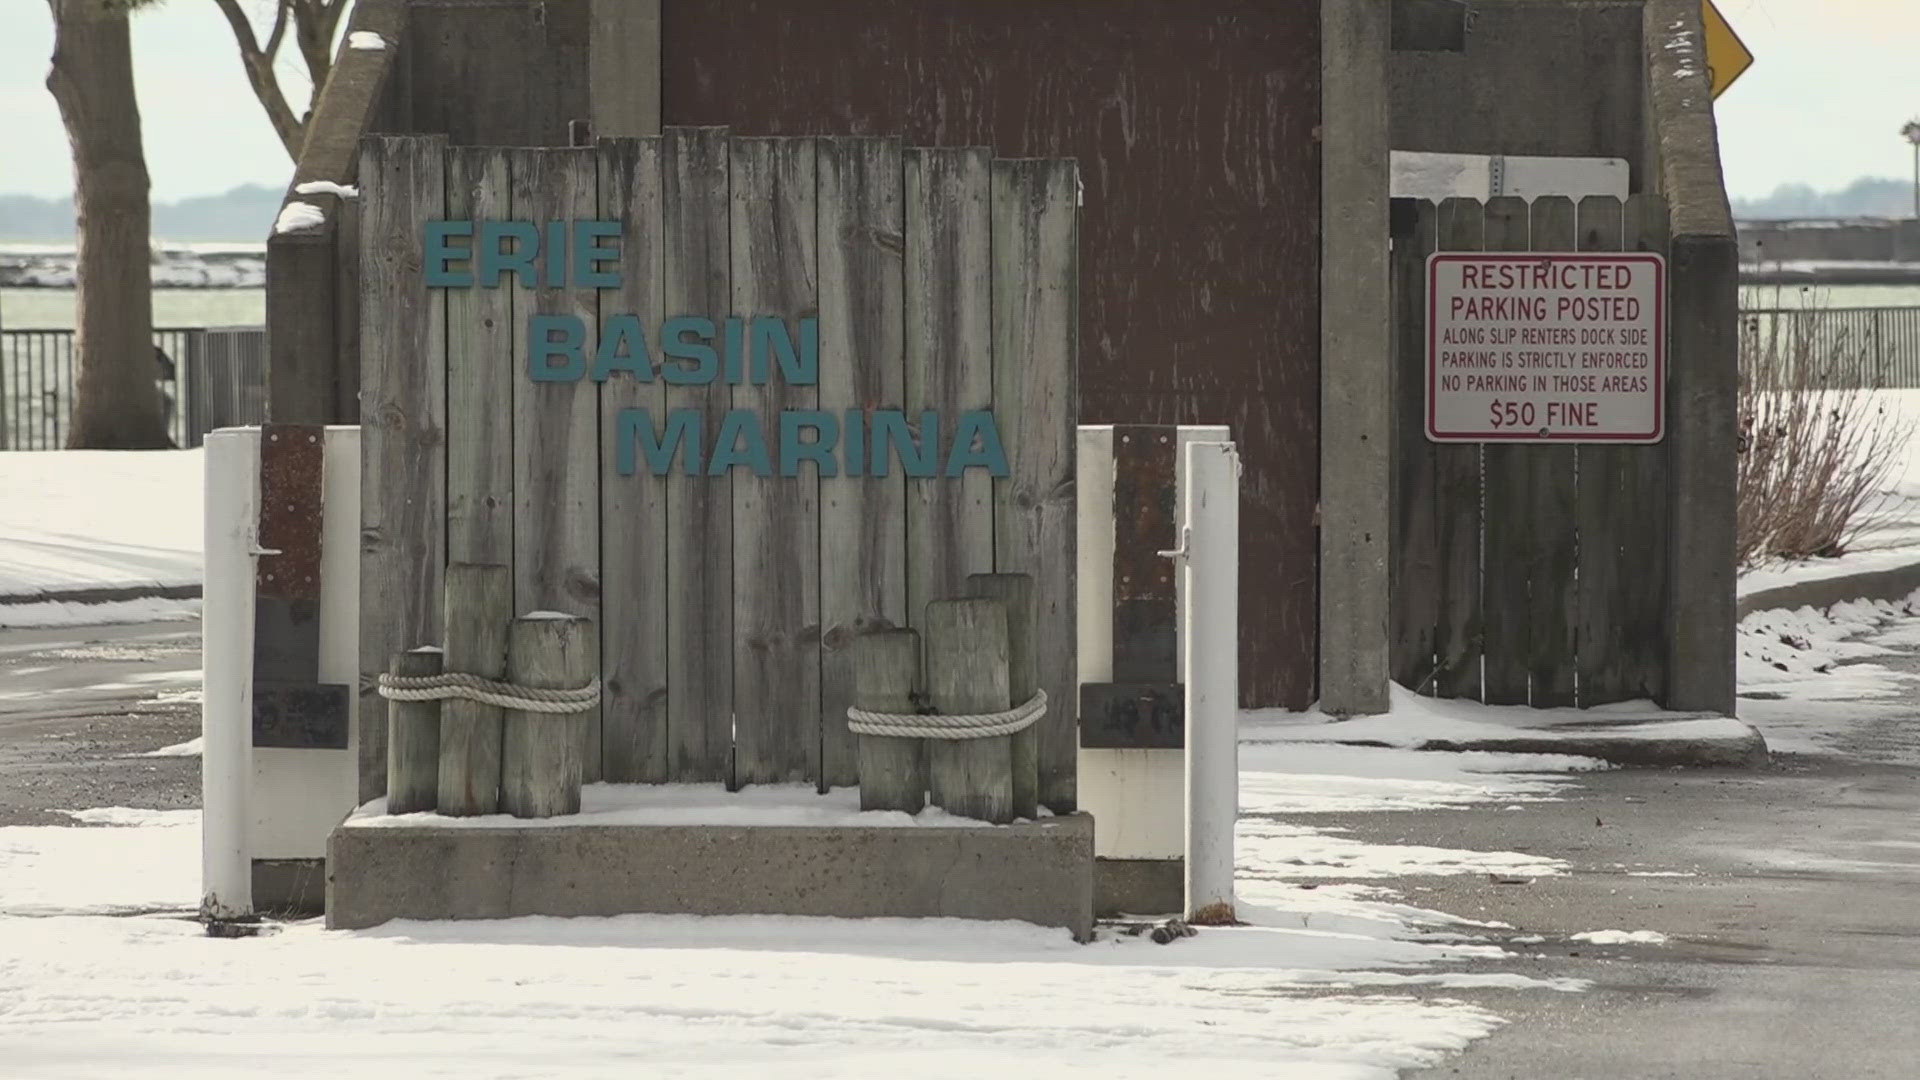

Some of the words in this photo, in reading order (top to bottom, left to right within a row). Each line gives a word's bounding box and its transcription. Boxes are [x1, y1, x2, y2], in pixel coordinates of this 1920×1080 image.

[424, 220, 623, 288] ERIE
[1462, 265, 1632, 290] RESTRICTED
[1451, 297, 1547, 321] PARKING
[1557, 297, 1640, 321] POSTED
[1443, 328, 1485, 345] ALONG
[1490, 328, 1517, 345] SLIP
[1522, 328, 1576, 345] RENTERS
[1581, 328, 1615, 345] DOCK
[1620, 328, 1648, 345] SIDE
[529, 314, 819, 385] BASIN
[1442, 352, 1496, 368] PARKING
[1502, 352, 1513, 368] IS
[1518, 352, 1576, 368] STRICTLY
[1582, 352, 1648, 369] ENFORCED
[1442, 375, 1460, 392] NO
[1467, 375, 1527, 392] PARKING
[1533, 375, 1547, 392] IN
[1553, 375, 1596, 392] THOSE
[1602, 375, 1648, 392] AREAS
[1490, 398, 1535, 429] $50
[1547, 402, 1599, 426] FINE
[616, 408, 1010, 478] MARINA
